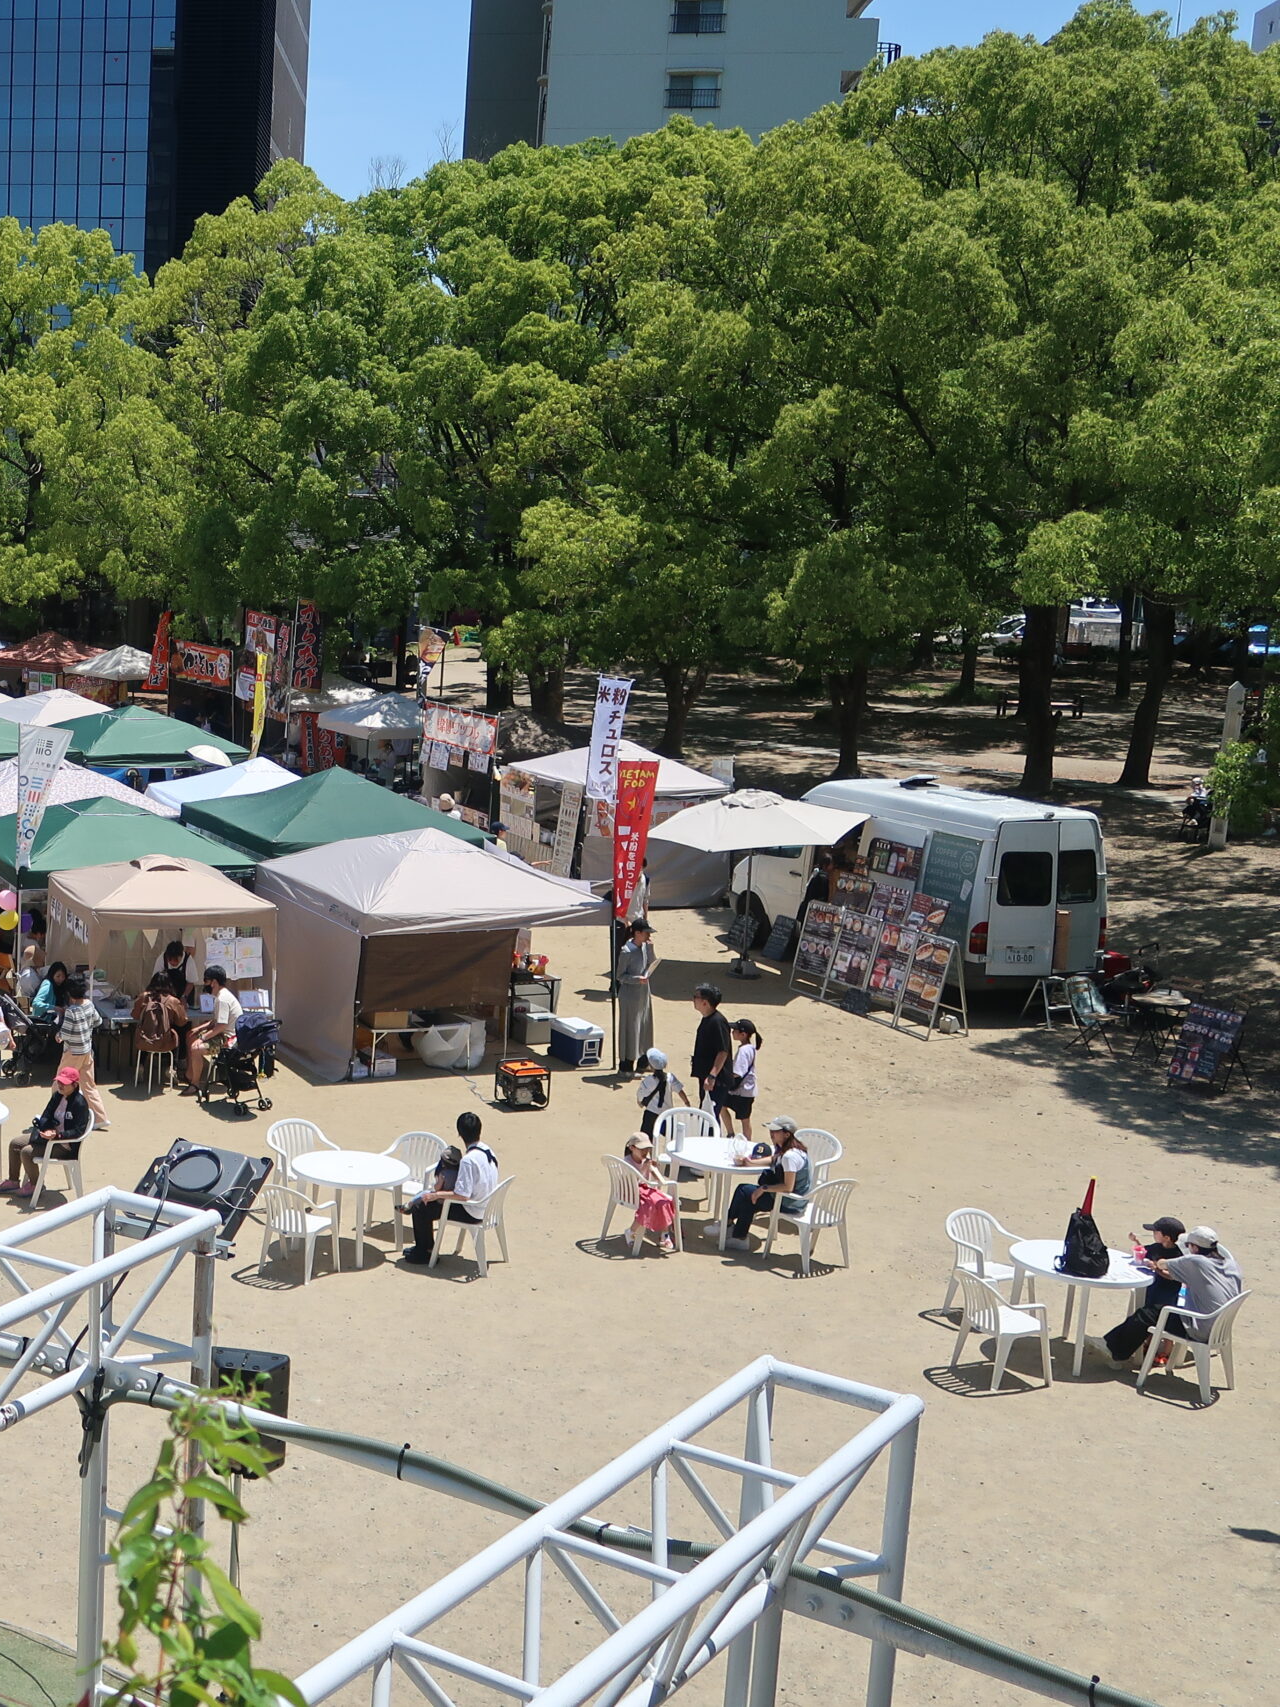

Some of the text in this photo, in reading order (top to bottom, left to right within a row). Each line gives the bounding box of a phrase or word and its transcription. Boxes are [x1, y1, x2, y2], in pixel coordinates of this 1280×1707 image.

[294, 603, 320, 689] からあげ
[598, 686, 627, 705] 米粉
[599, 710, 621, 775] チュロス
